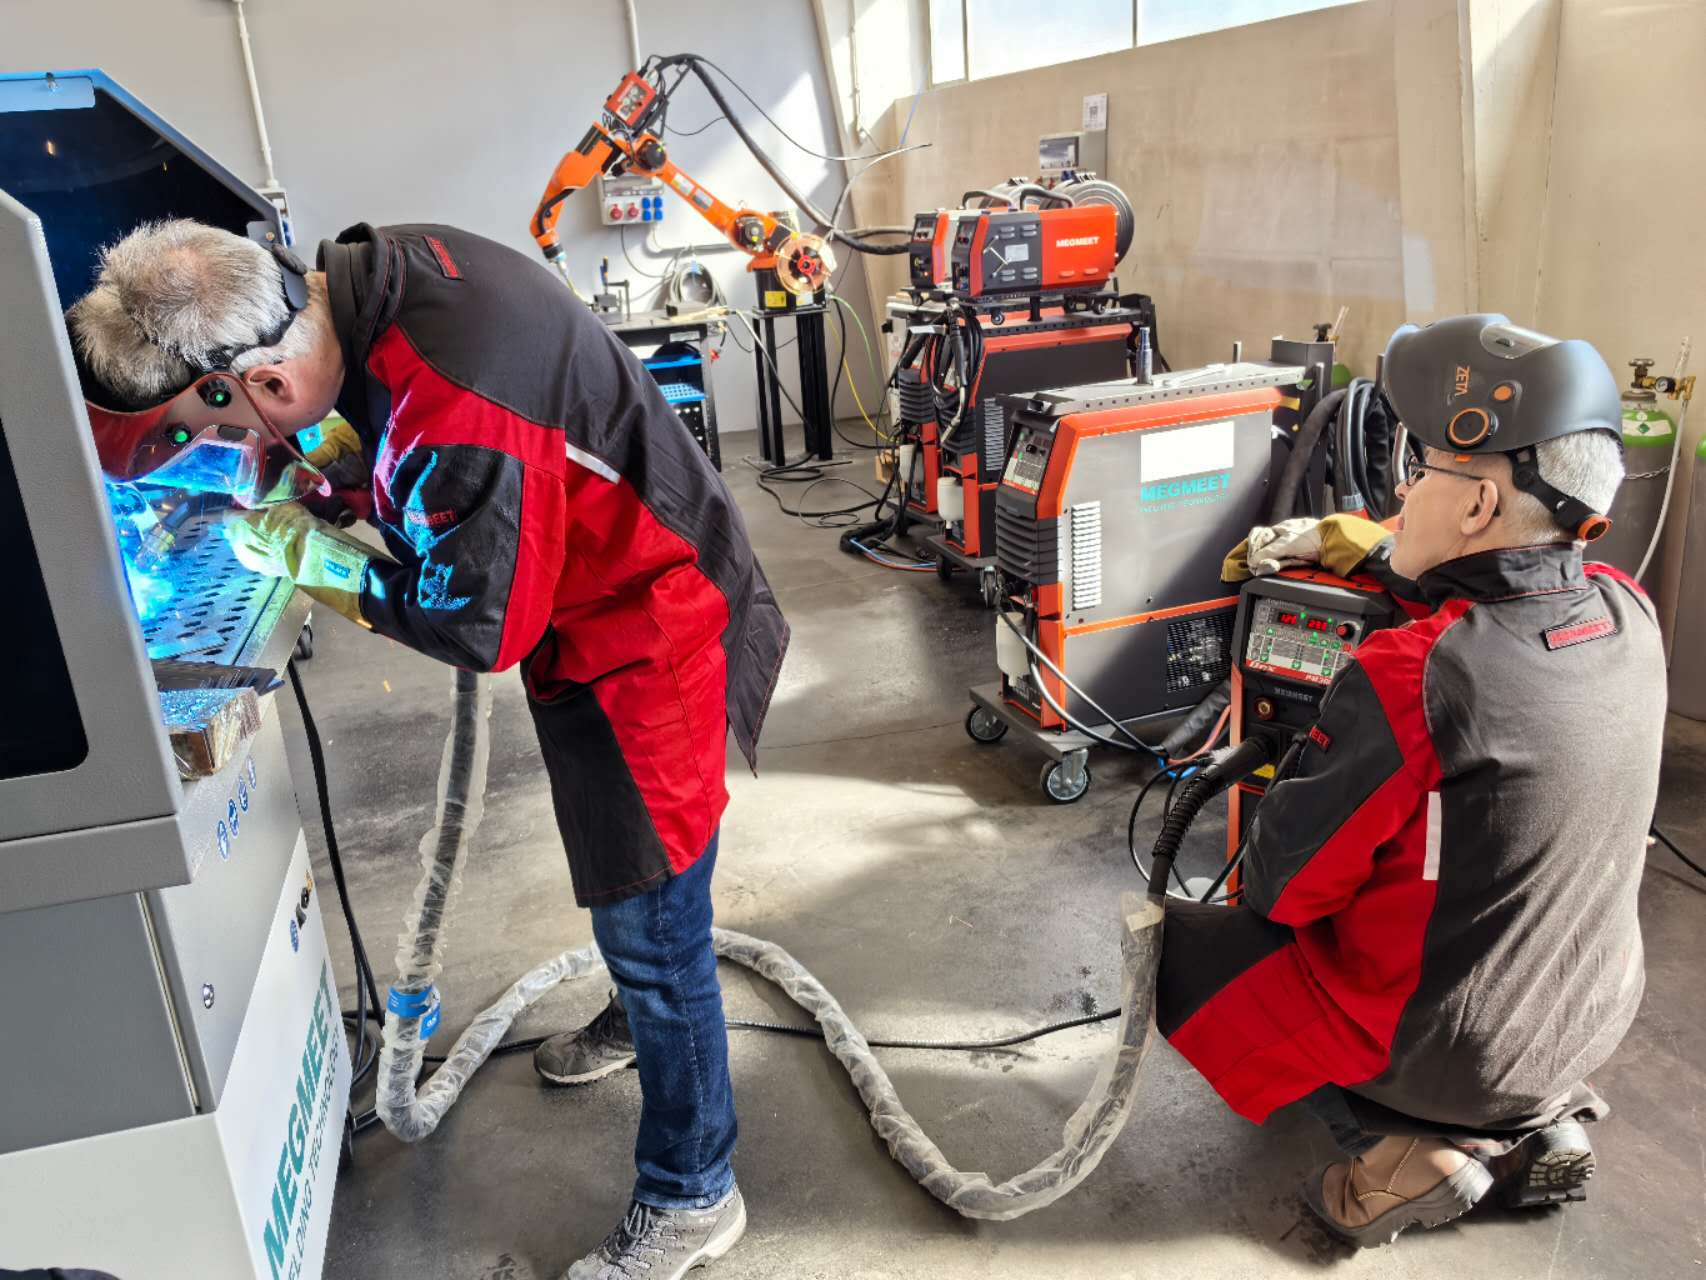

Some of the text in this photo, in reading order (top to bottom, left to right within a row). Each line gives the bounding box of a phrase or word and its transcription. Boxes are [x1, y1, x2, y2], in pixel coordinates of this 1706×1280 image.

[1455, 365, 1471, 396] ZETA
[1140, 472, 1232, 502] MEGMEET
[263, 958, 332, 1280] MEGMEET
[288, 1179, 312, 1280] ELDING
